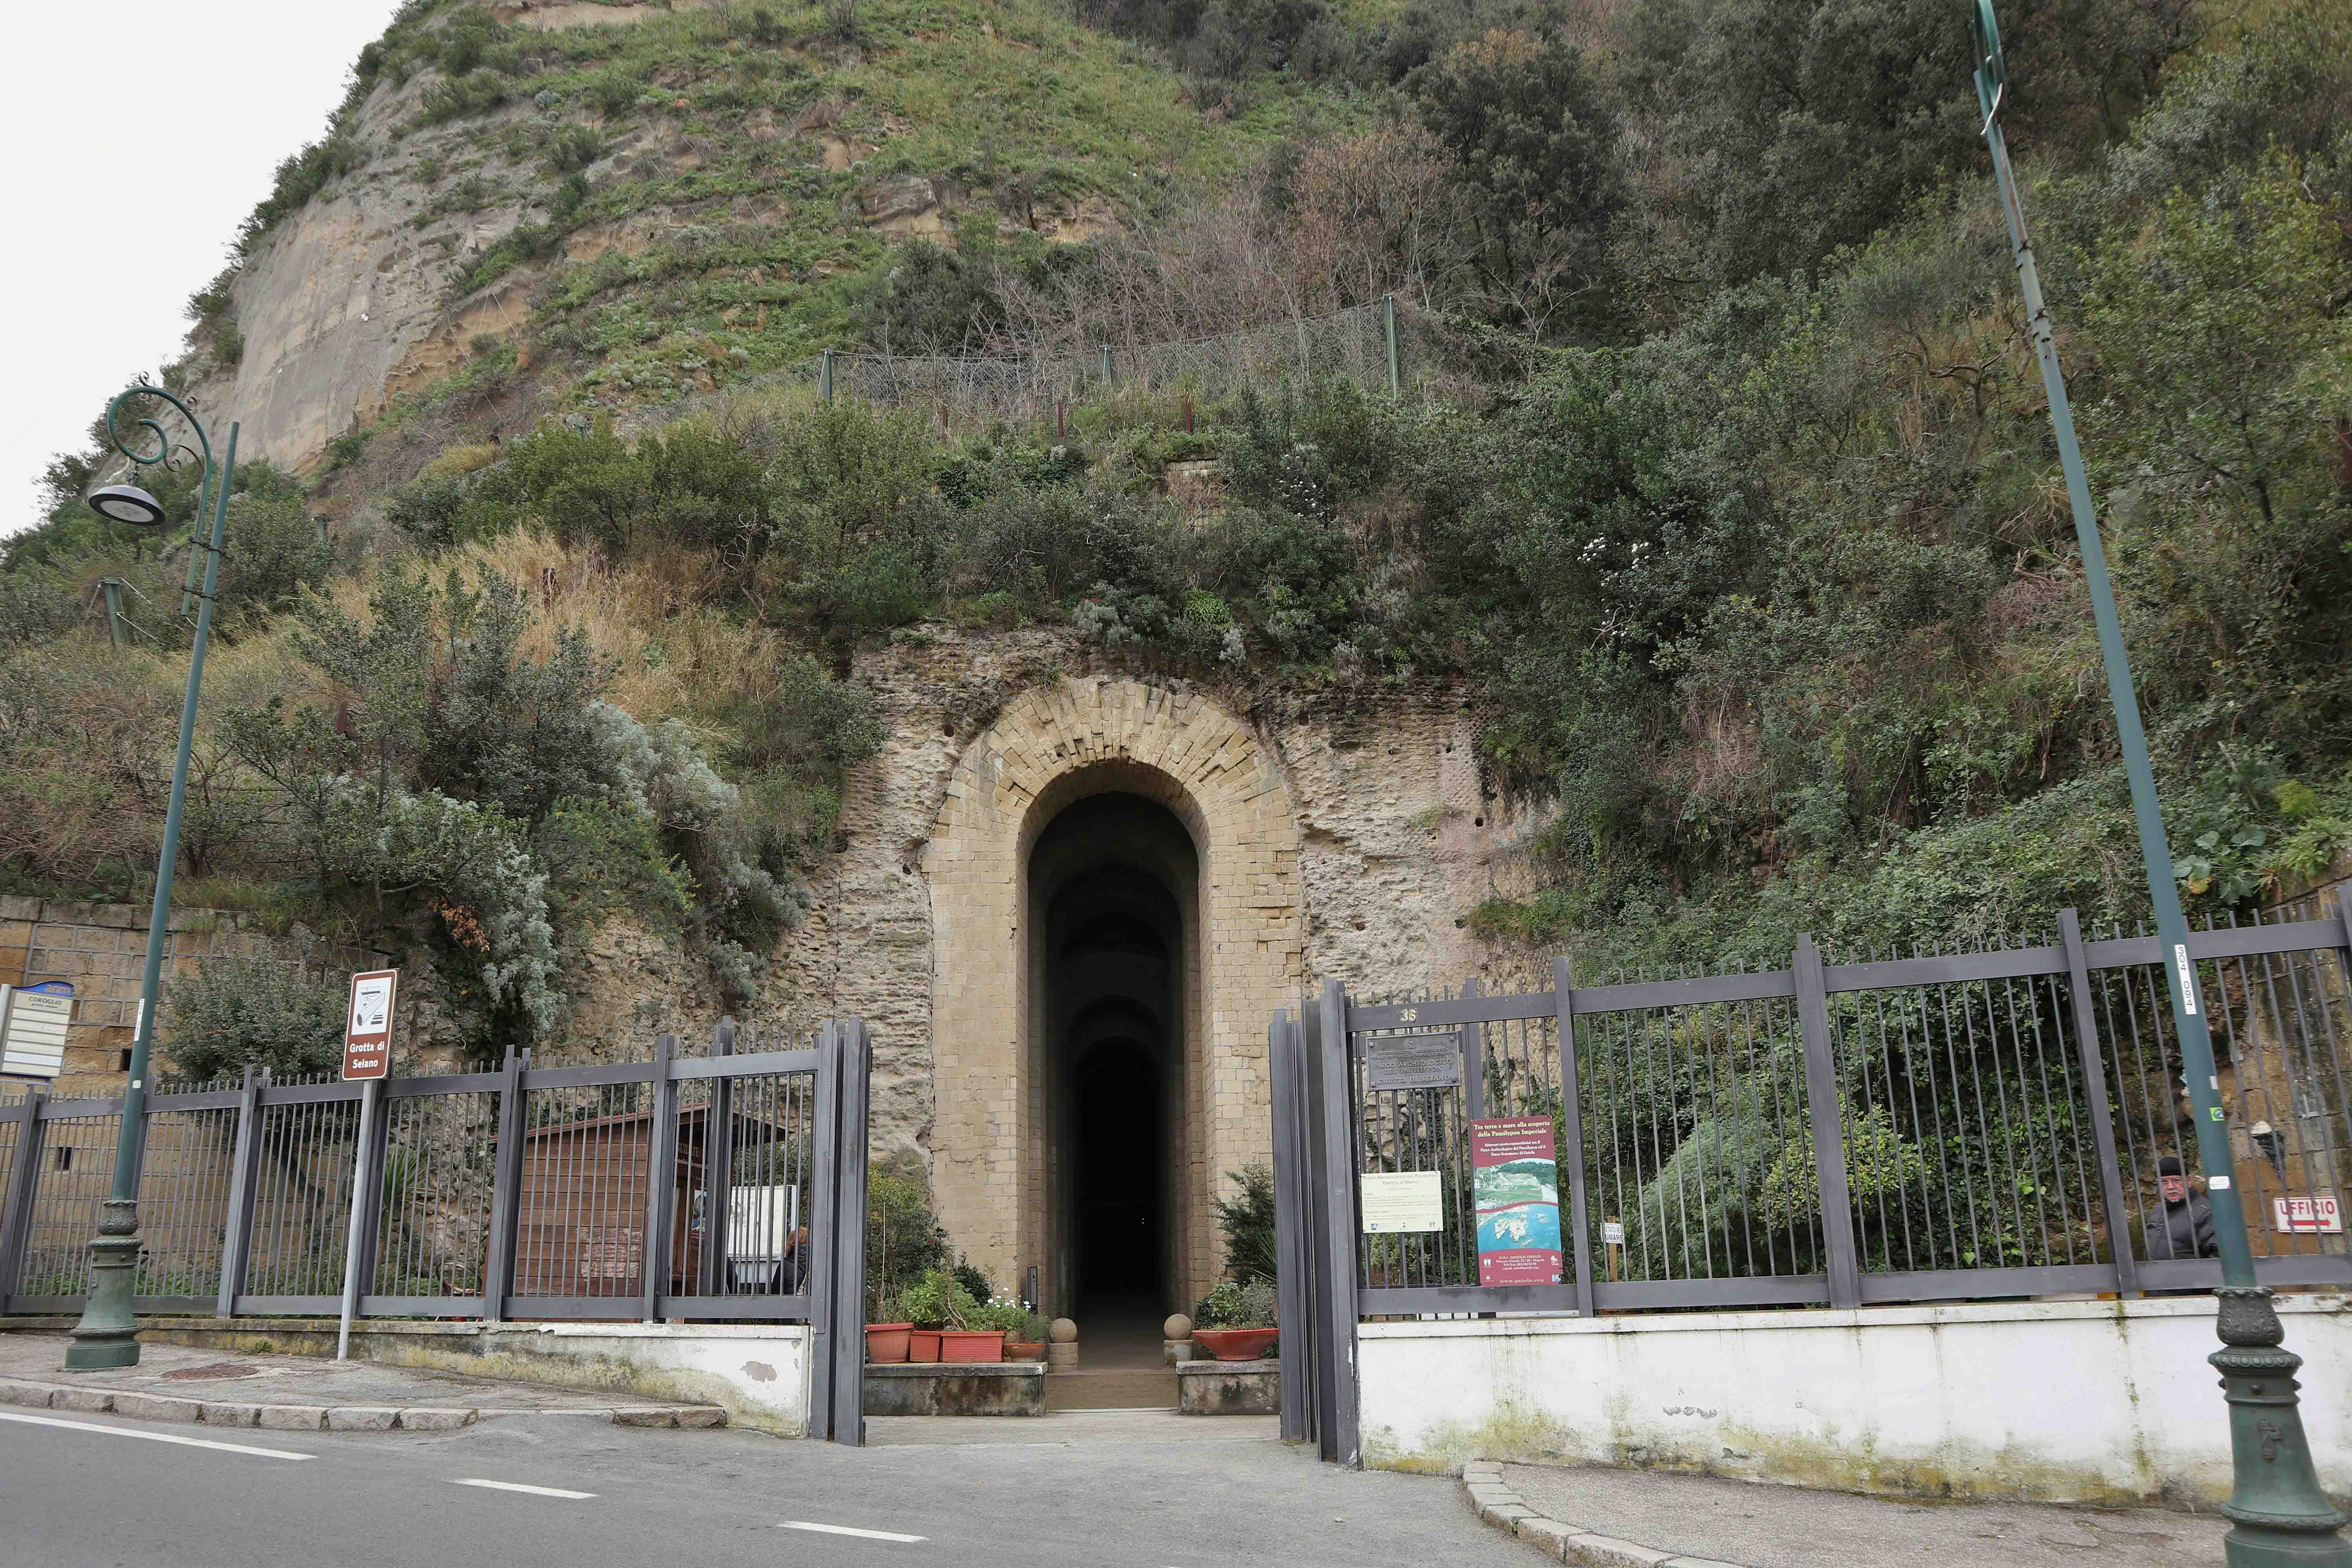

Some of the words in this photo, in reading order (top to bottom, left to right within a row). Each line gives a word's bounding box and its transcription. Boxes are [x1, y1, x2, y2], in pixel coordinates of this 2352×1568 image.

[2178, 947, 2187, 971] 304
[2183, 981, 2193, 1007] 094
[44, 984, 70, 994] anm
[29, 996, 63, 1005] COROGLIO
[1400, 1008, 1417, 1023] 36
[349, 1042, 374, 1053] Grotta
[377, 1041, 385, 1051] di
[352, 1058, 379, 1069] Seiano
[1398, 1059, 1452, 1067] ARCHEOLOGICO
[1401, 1065, 1443, 1074] PAUSILYPON
[2279, 1200, 2336, 1215] UFFICIO
